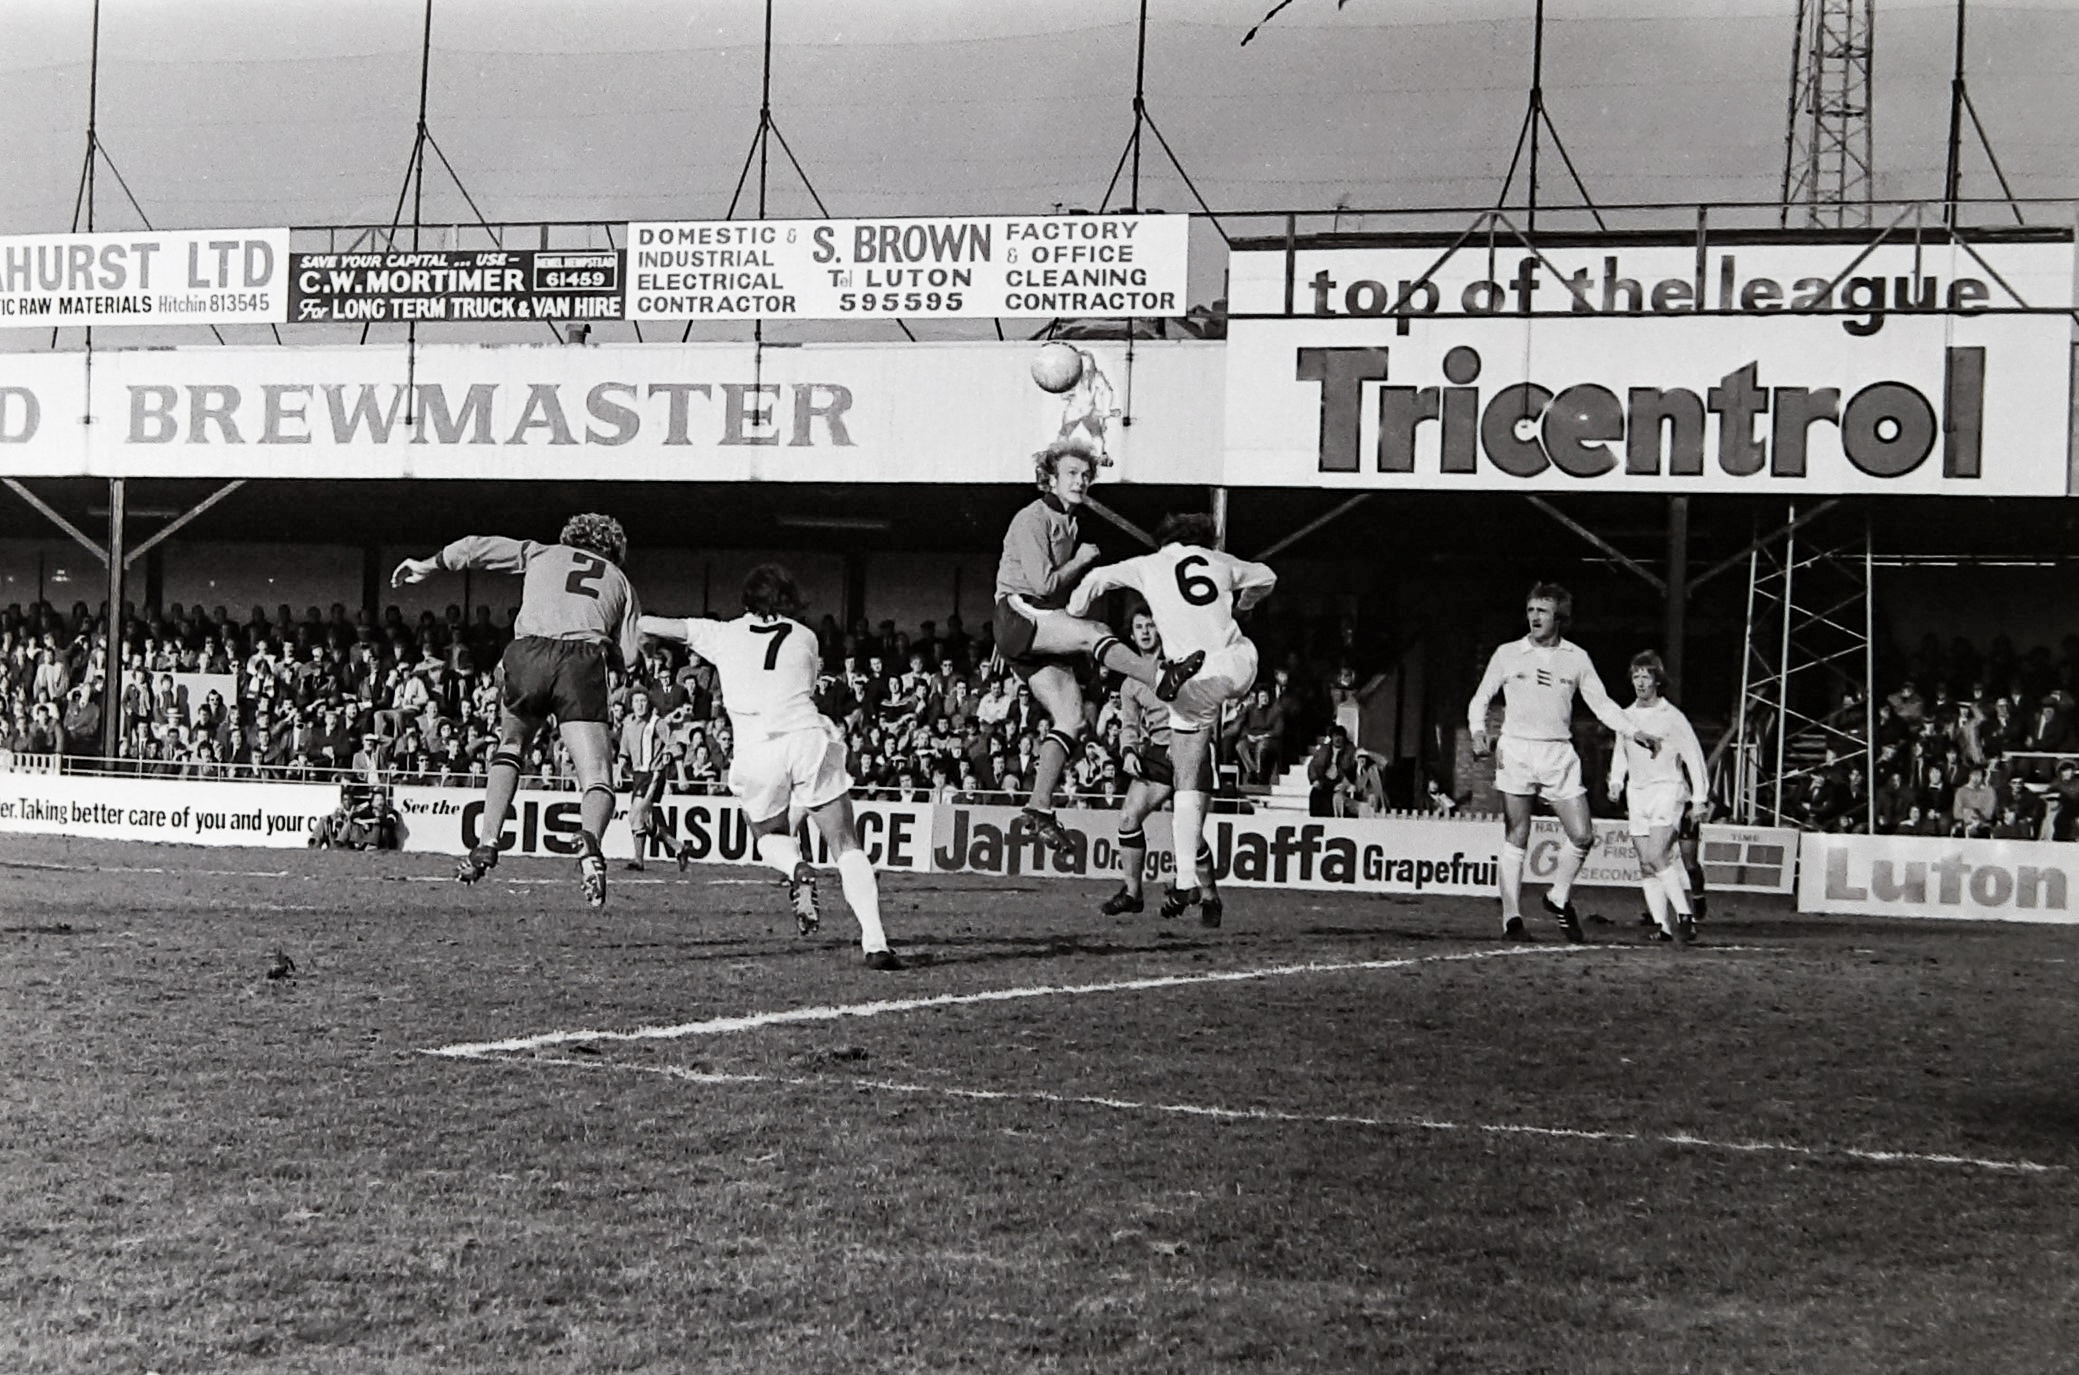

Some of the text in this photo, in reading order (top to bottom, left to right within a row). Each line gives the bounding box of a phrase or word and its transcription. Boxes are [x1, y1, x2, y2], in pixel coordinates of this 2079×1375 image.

[639, 227, 776, 245] DOMESTIC
[1006, 221, 1139, 241] FACTORY
[812, 224, 991, 263] S. BROWN
[1031, 245, 1134, 263] OFFICE
[0, 240, 274, 292] HURST LTD
[300, 255, 337, 268] SAVE
[341, 254, 381, 268] YOUR
[386, 253, 448, 267] CAPITAL
[638, 250, 774, 268] INDUSTRIAL
[546, 271, 605, 287] 61459
[638, 272, 784, 290] ELECTRICAL
[827, 268, 972, 288] Tel LUTON
[1005, 268, 1147, 287] CLEANING
[19, 297, 51, 316] RAW
[59, 295, 152, 315] MATERIALS
[158, 294, 207, 314] Hitchin
[209, 293, 270, 313] 813545
[637, 295, 797, 313] CONTRACTOR
[839, 292, 963, 312] 595595
[1005, 291, 1175, 311] CONTRACTOR
[1308, 255, 1992, 336] top of the league
[298, 298, 329, 320] For
[332, 298, 386, 319] LONG
[390, 297, 446, 319] TERM
[574, 296, 621, 317] HIRE
[125, 381, 858, 448] BREWMASTER
[1295, 345, 1987, 479] Tricentrol
[565, 551, 606, 600] 2
[1175, 555, 1219, 606] 6
[749, 622, 792, 670] 7
[19, 798, 67, 825] Taking
[72, 801, 124, 825] better
[129, 808, 166, 827] care
[171, 806, 190, 828] of
[195, 812, 226, 834] you
[230, 808, 262, 831] and
[266, 815, 304, 836] your
[401, 798, 460, 815] See the
[462, 800, 583, 854] CIS
[649, 805, 916, 867] NSUCE
[1093, 838, 1178, 880] Orge
[1214, 822, 1499, 890] Jaffa Grapefrui
[1604, 846, 1639, 859] FIRS
[1825, 847, 2068, 910] Luton
